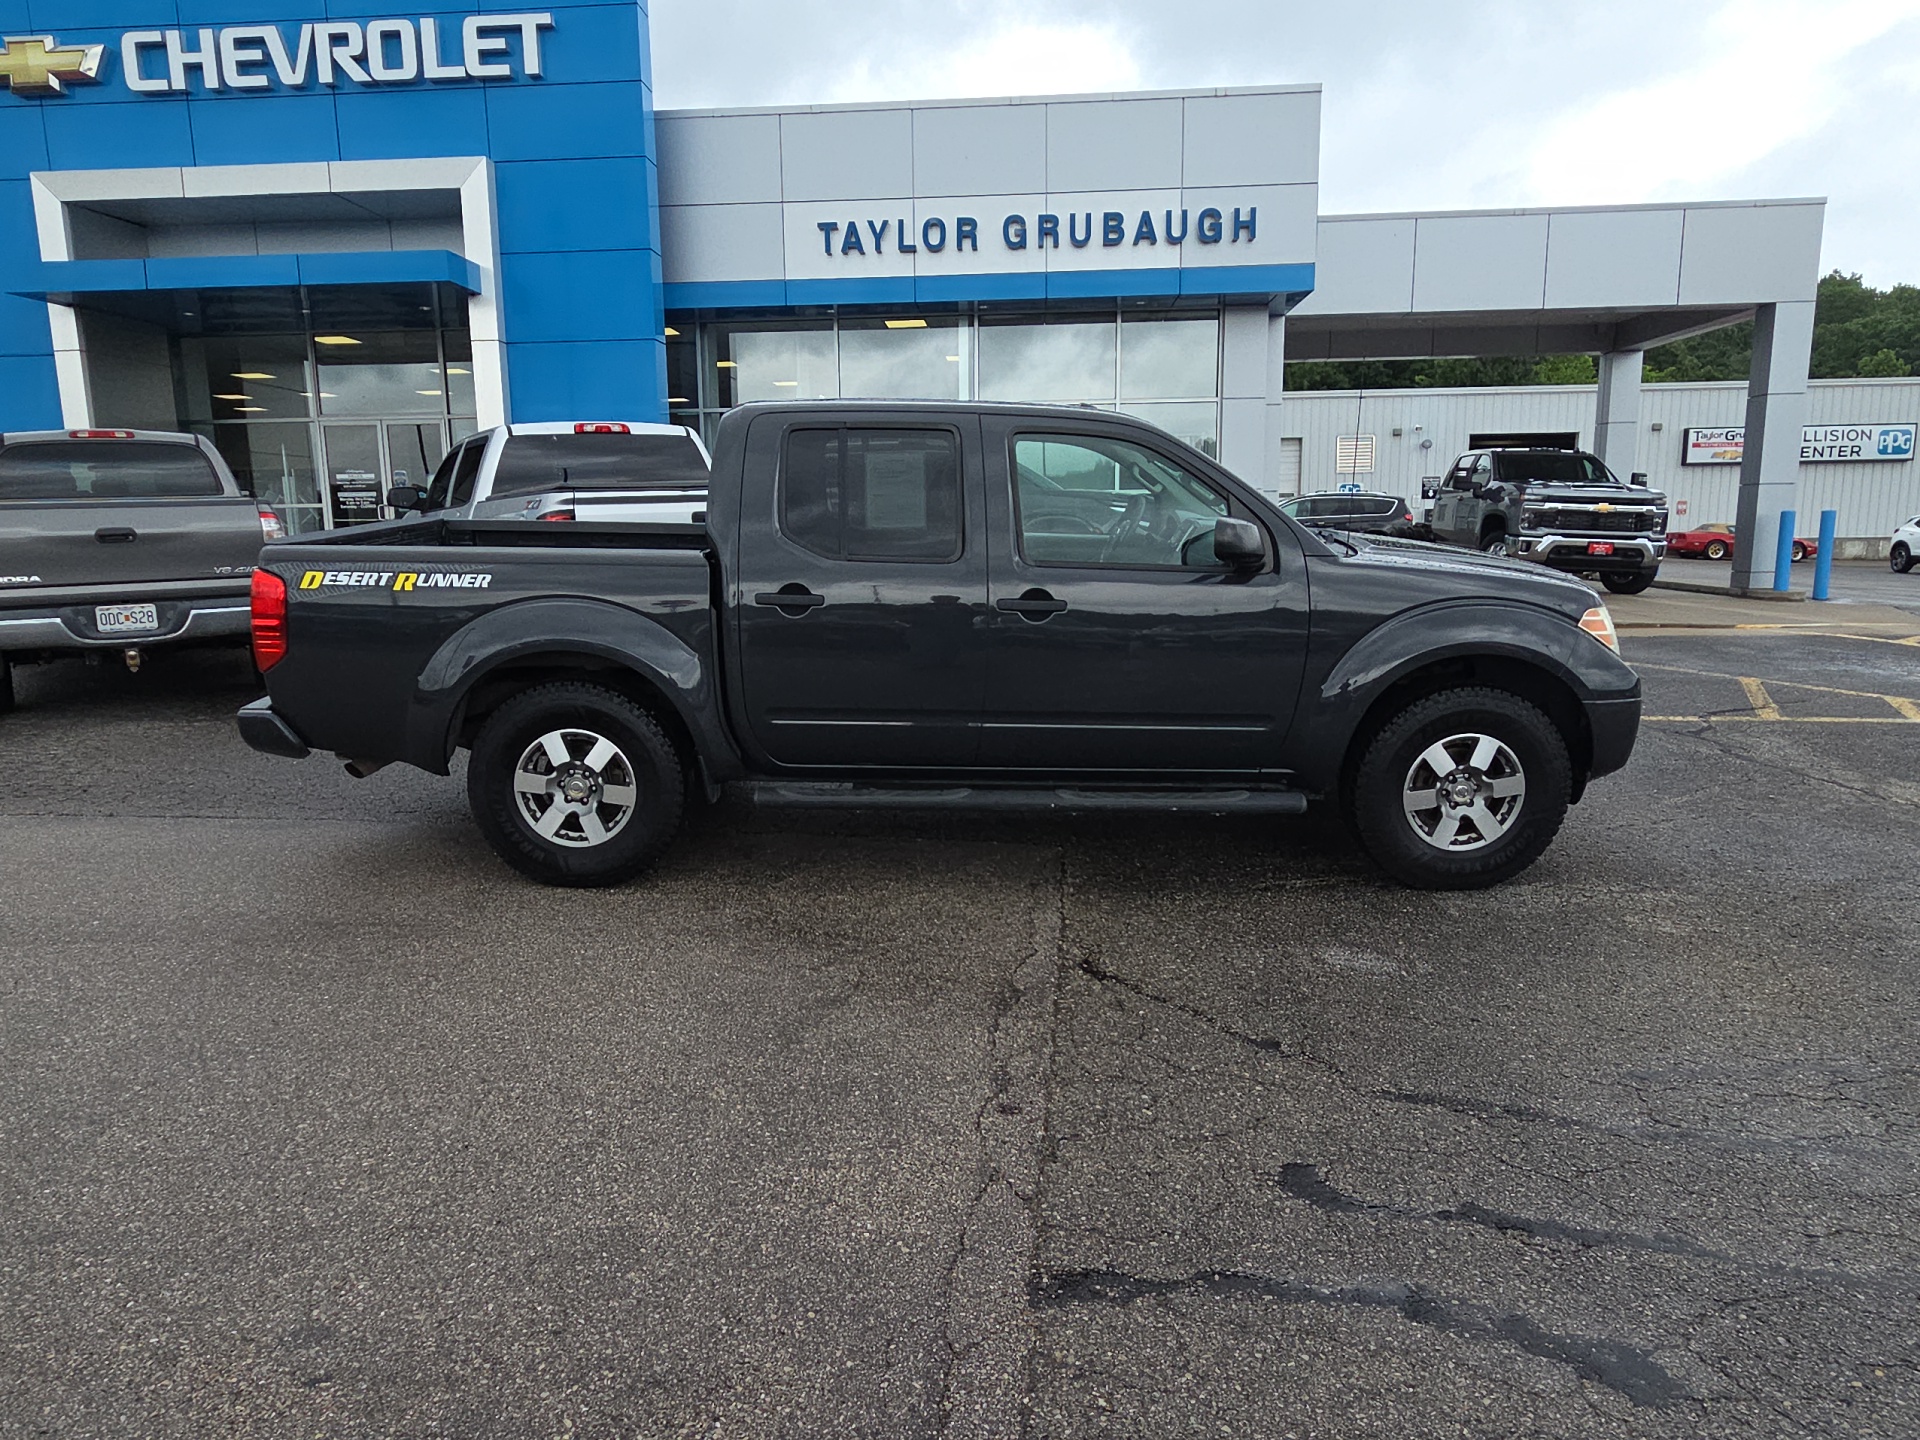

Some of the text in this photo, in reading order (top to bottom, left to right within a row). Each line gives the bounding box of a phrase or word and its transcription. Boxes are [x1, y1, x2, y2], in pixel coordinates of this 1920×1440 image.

[121, 13, 553, 91] CHEVROLET
[817, 206, 1258, 256] TAYLOR GRUBAUGH
[1878, 431, 1911, 453] PPG
[300, 571, 492, 591] DESERT RUNNER
[130, 610, 155, 624] S28
